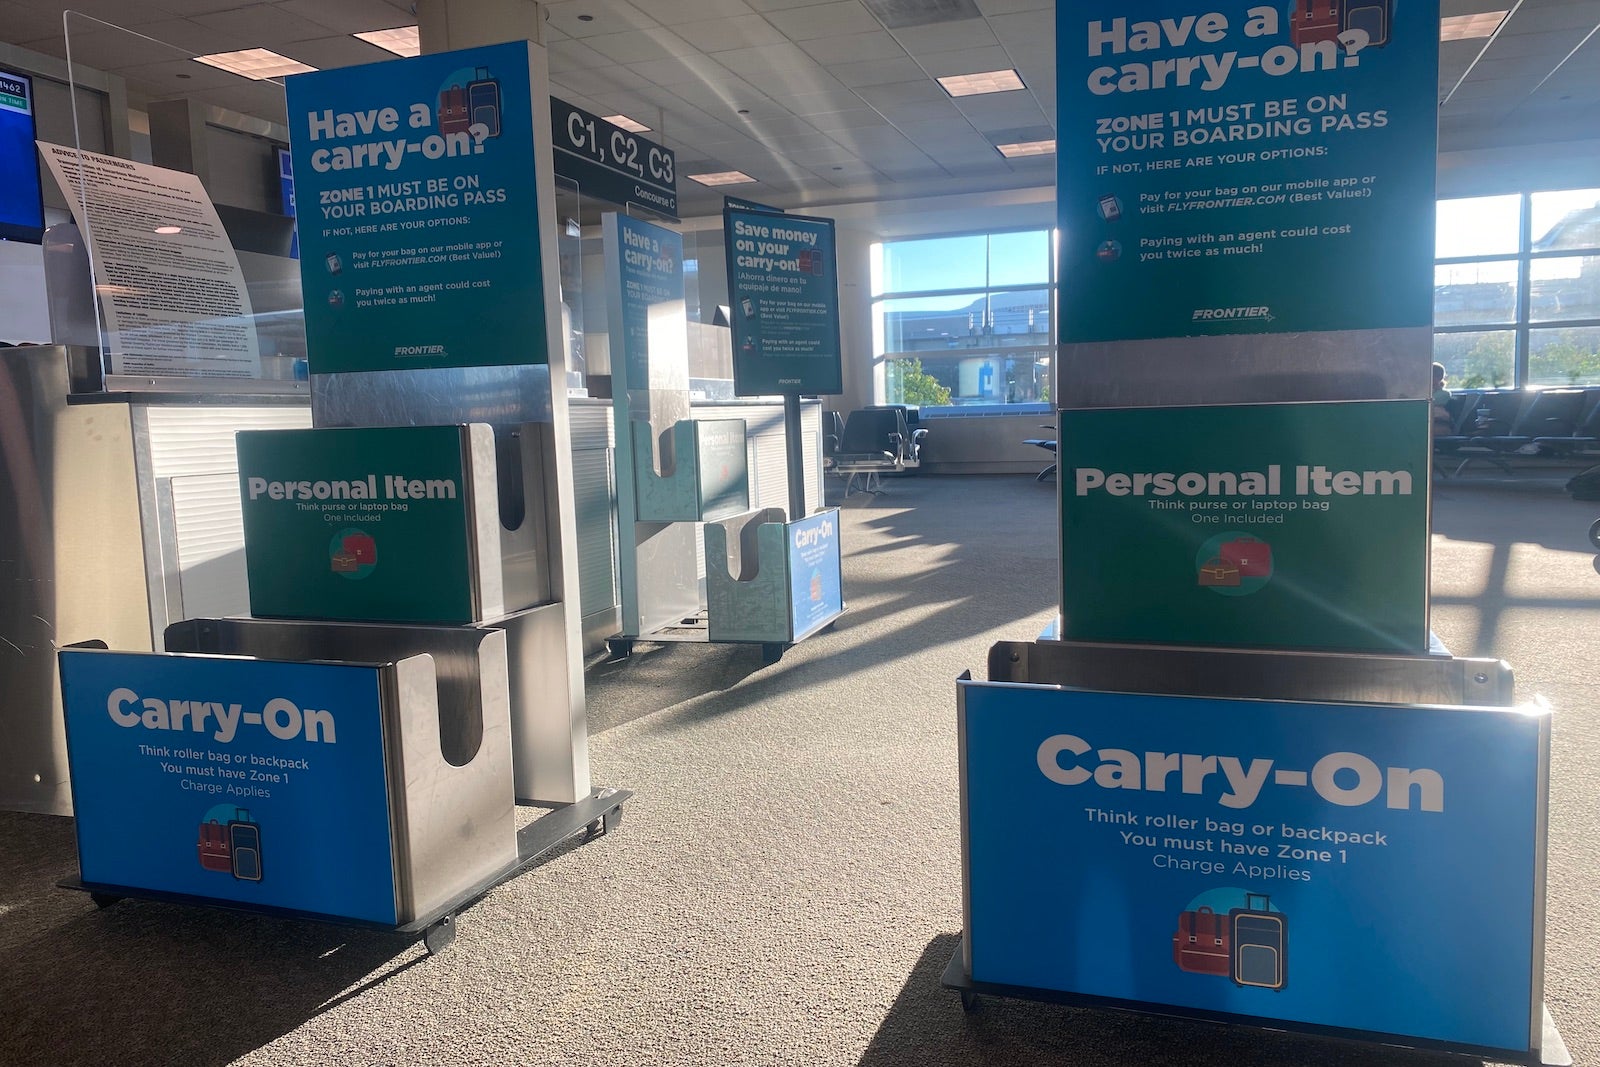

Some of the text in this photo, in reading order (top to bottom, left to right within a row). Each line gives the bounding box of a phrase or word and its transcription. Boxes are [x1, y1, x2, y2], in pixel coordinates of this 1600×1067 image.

[1089, 6, 1278, 56] Have a
[1087, 29, 1370, 96] carry-on?
[308, 103, 431, 141] Have a
[1096, 94, 1346, 134] ZONE 1 MUST BE ON
[1097, 110, 1388, 153] YOUR BOARDING PASS
[311, 122, 490, 173] carry-on?
[567, 112, 674, 184] C1, C2, C3
[1097, 146, 1328, 175] IF NOT, HERE ARE YOUR OPTIONS:
[320, 175, 479, 204] ZONE 1 MUST BE ON
[634, 185, 675, 209] Concourse C
[1140, 193, 1160, 202] Pay
[1164, 191, 1181, 200] for
[1185, 190, 1211, 199] your
[1215, 187, 1238, 196] bag
[1261, 184, 1282, 192] our
[1286, 179, 1329, 190] mobile
[1333, 178, 1358, 187] app
[1362, 176, 1376, 184] or
[1140, 188, 1371, 214] visit FLYFRONTIER.COM (Best Value!)
[321, 189, 506, 219] YOUR BOARDING PASS
[323, 216, 470, 237] IF NOT, HERE ARE YOUR OPTIONS:
[735, 221, 817, 245] Save money
[1140, 224, 1351, 247] Paying with an agent could cost
[381, 250, 399, 258] your
[401, 248, 416, 256] bag
[446, 242, 473, 251] mobile
[623, 226, 659, 253] Have a
[736, 239, 789, 256] on your
[1140, 243, 1262, 261] you twice as much!
[354, 250, 501, 269] visit FLYFRONTIER.COM (Best Value!)
[625, 249, 673, 274] carry-on?
[737, 255, 800, 271] carry-on!
[356, 288, 383, 297] Paying
[386, 285, 404, 294] with
[419, 283, 443, 292] agent
[445, 280, 469, 289] could
[739, 283, 769, 292] equipaje
[766, 275, 788, 284] dinero
[374, 297, 396, 305] twice
[410, 294, 435, 303] much!
[1192, 306, 1269, 319] FRONTIER
[394, 345, 444, 355] FRONTIER
[248, 475, 456, 500] Personal Item
[1076, 465, 1412, 496] Personal Item
[322, 504, 346, 512] purse
[360, 502, 388, 512] laptop
[391, 502, 408, 511] bag
[1148, 500, 1185, 509] Think
[1190, 502, 1227, 511] purse
[1252, 500, 1297, 511] laptop
[1303, 500, 1329, 511] bag
[1192, 513, 1283, 523] One Included
[796, 520, 832, 549] Carry-On
[107, 687, 337, 744] Carry-On
[139, 745, 309, 769] Think roller bag or backpack
[160, 762, 288, 783] You must have Zone 1
[1036, 734, 1444, 813] Carry-On
[181, 779, 270, 798] Charge Applies
[1085, 808, 1387, 845] Think roller bag or backpack
[1120, 831, 1346, 863] You must have Zone 1
[1153, 854, 1311, 881] Charge Applies
